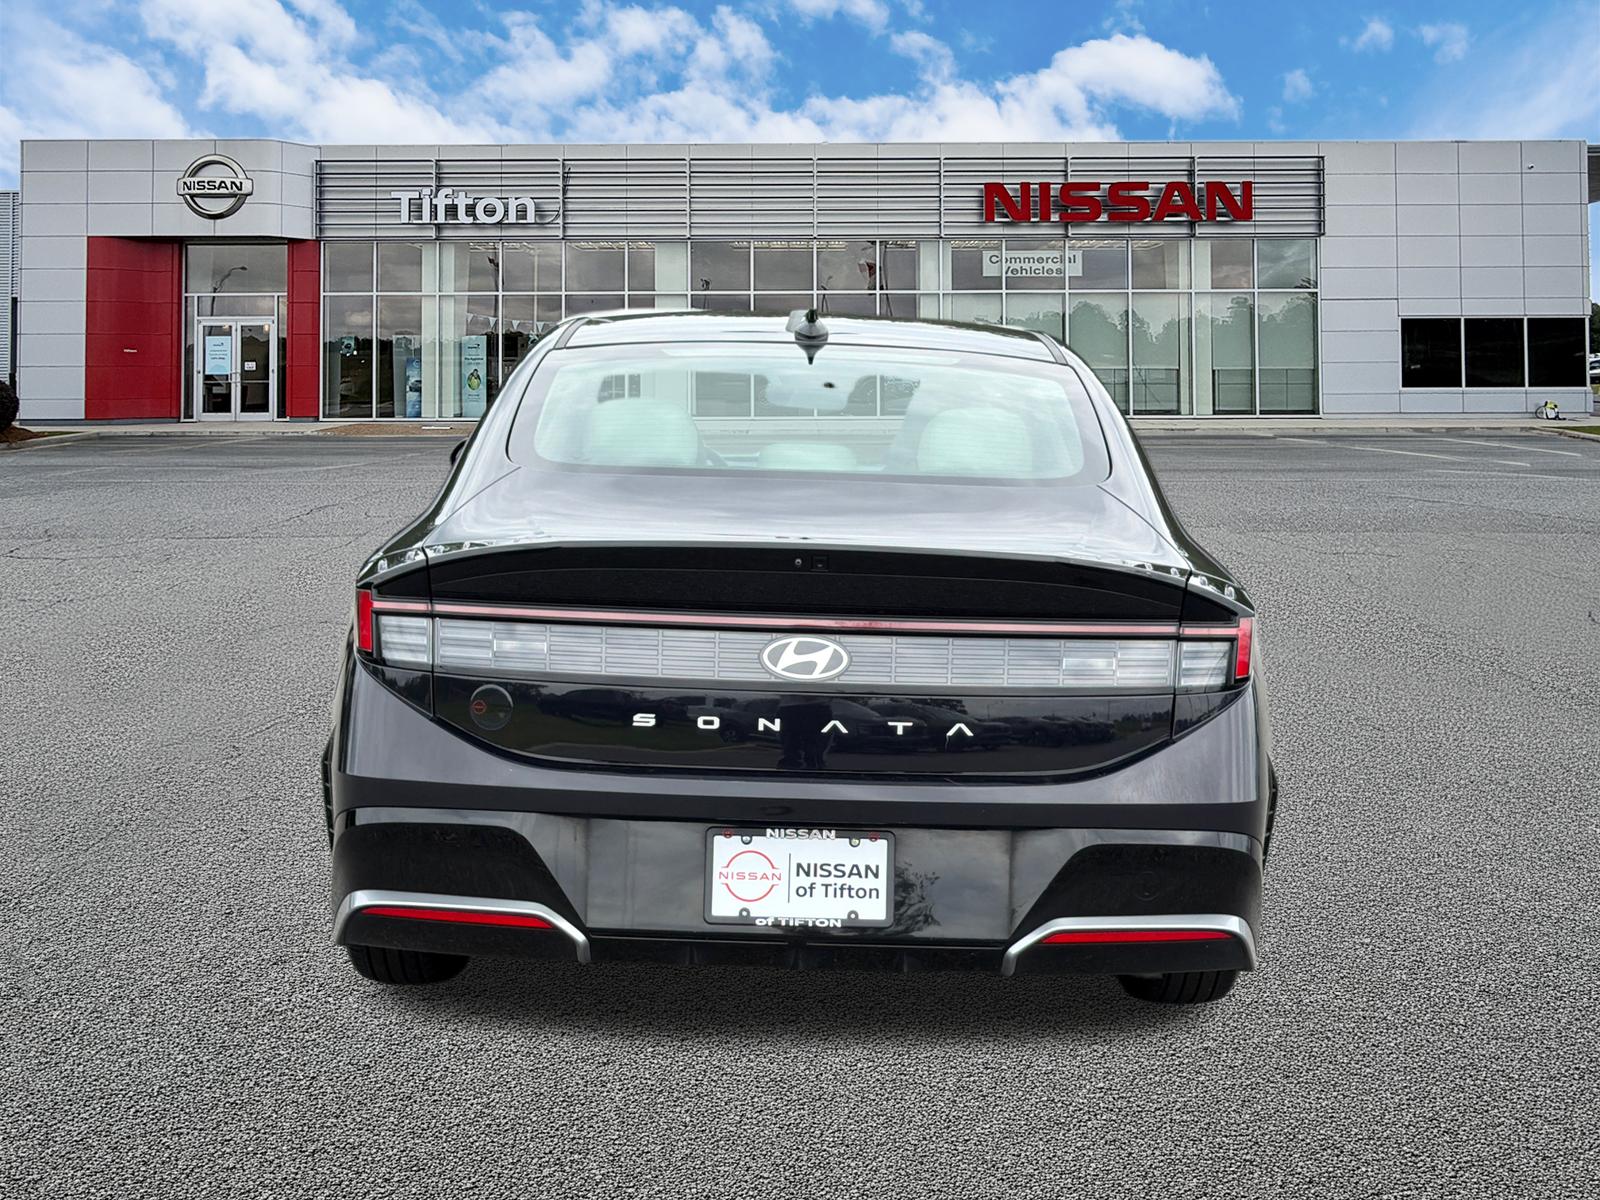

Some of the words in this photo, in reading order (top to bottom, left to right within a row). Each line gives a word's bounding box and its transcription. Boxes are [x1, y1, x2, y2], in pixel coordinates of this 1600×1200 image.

[183, 180, 243, 191] NISSAN
[391, 187, 535, 224] Tifton
[983, 181, 1253, 222] NISSAN
[632, 712, 974, 737] SONATA
[765, 828, 836, 840] NISSAN
[718, 871, 782, 881] NISSAN
[795, 863, 880, 879] NISSAN
[795, 882, 816, 898] of
[821, 883, 880, 899] Tifton
[777, 918, 842, 928] TIFTON
